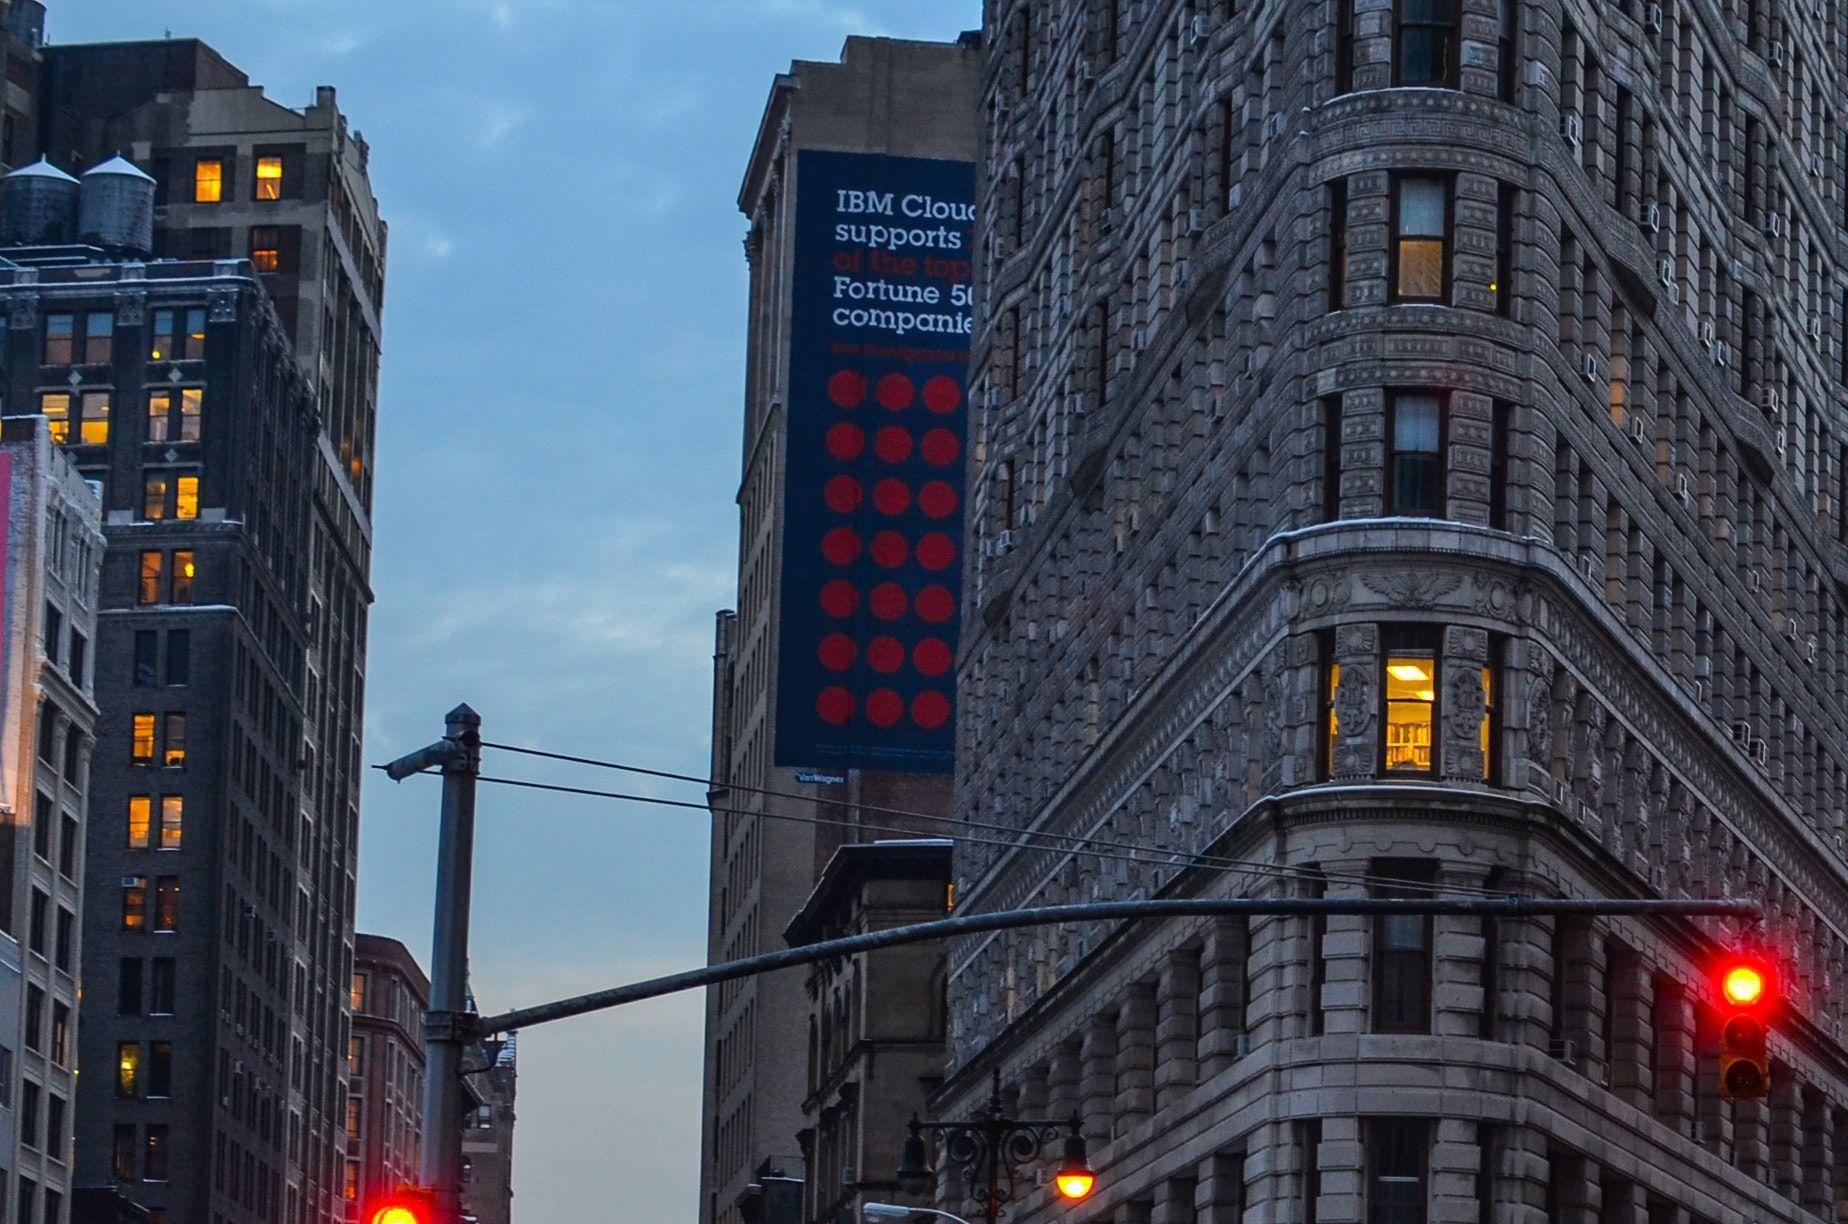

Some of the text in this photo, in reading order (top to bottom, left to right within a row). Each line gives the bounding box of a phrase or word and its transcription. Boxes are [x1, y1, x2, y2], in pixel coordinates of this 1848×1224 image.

[836, 189, 894, 216] IBM
[835, 223, 962, 250] supports
[834, 251, 861, 271] of
[871, 251, 919, 276] the
[833, 276, 940, 304] Fortune
